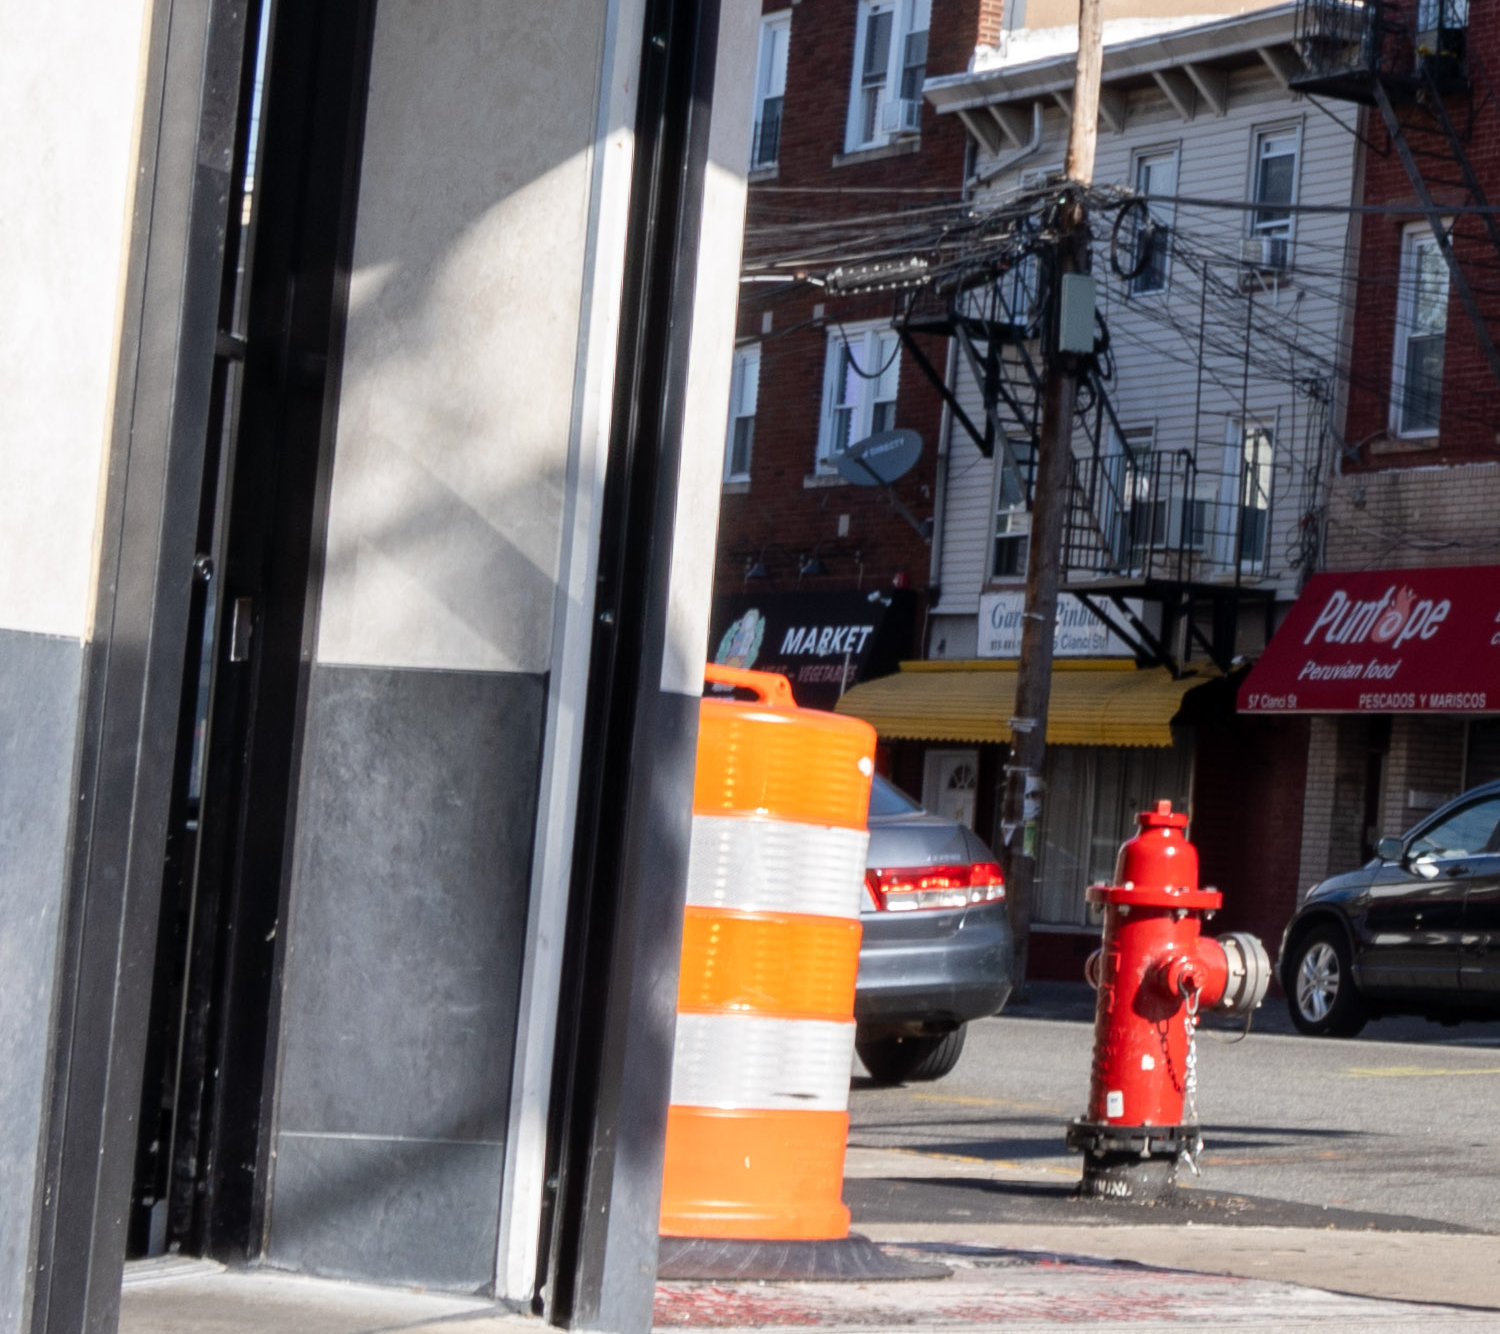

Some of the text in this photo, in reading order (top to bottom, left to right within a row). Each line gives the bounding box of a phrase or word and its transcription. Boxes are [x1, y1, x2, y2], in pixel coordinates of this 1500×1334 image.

[780, 625, 874, 656] MARKET
[1297, 658, 1403, 681] Peruvian food
[1260, 694, 1285, 708] Cianci
[1287, 694, 1298, 708] St
[1359, 693, 1486, 708] PESCADOS Y MARISCOS
